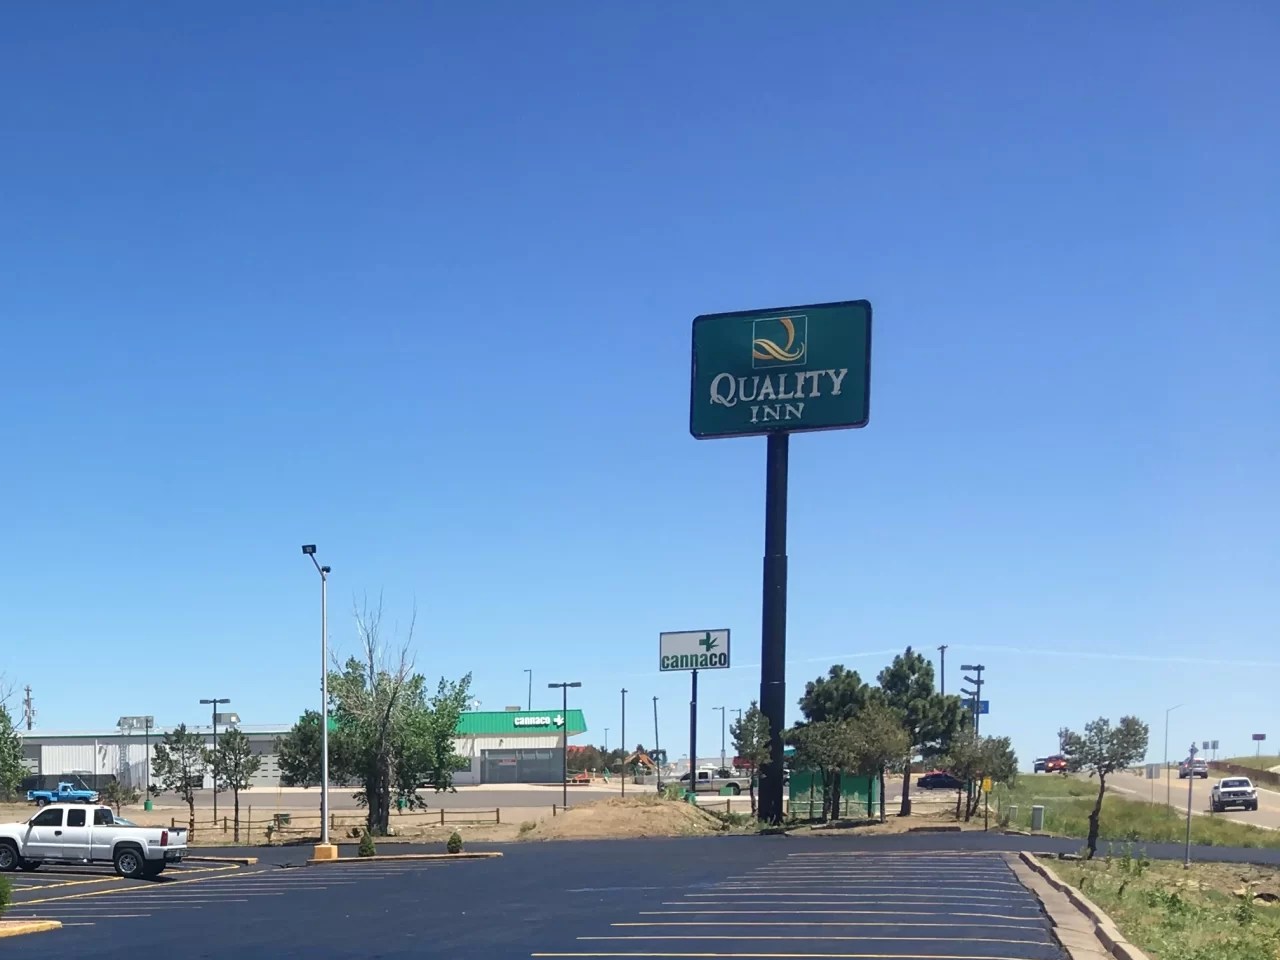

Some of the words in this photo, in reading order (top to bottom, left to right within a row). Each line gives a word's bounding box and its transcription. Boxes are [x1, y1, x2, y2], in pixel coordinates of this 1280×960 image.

[709, 368, 848, 407] QUALITY
[750, 402, 805, 424] INN
[661, 652, 727, 669] cannaco
